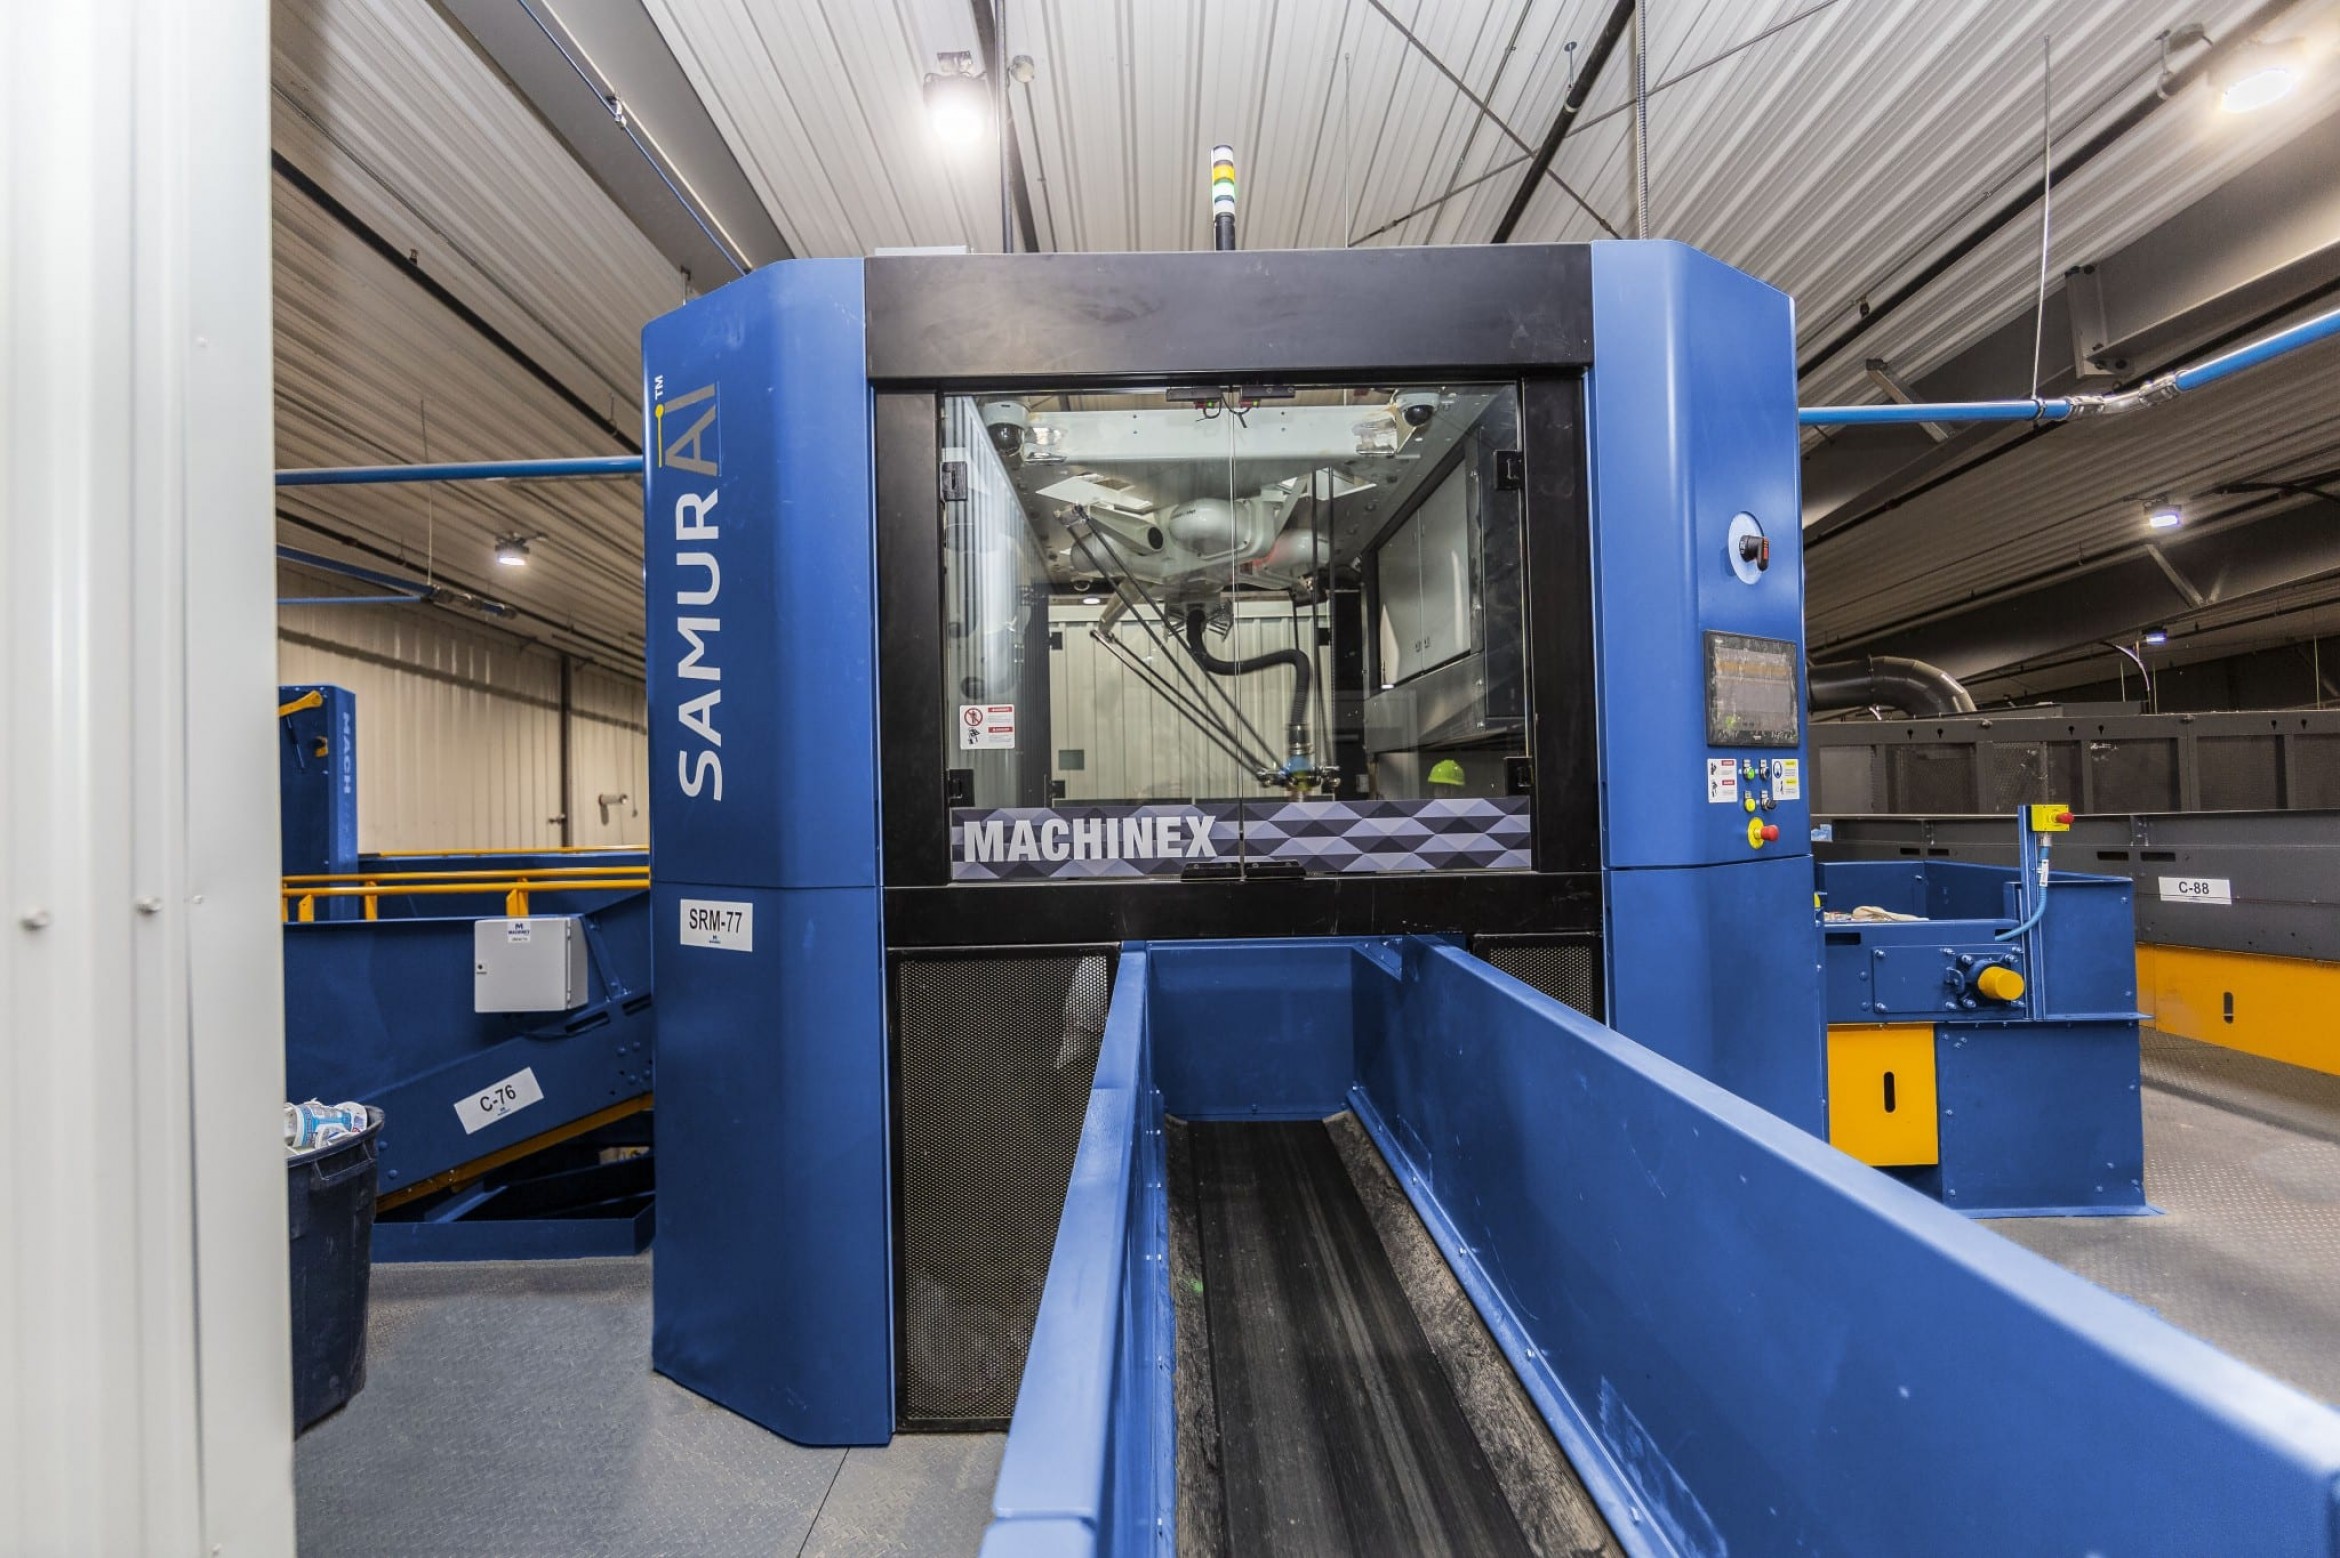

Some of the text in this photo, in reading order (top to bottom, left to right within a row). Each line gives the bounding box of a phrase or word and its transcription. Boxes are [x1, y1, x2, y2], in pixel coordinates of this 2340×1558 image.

[963, 815, 1218, 863] MACHINEX
[2178, 881, 2210, 895] C-88
[689, 908, 743, 934] SRM-77
[479, 1084, 517, 1113] C-76
